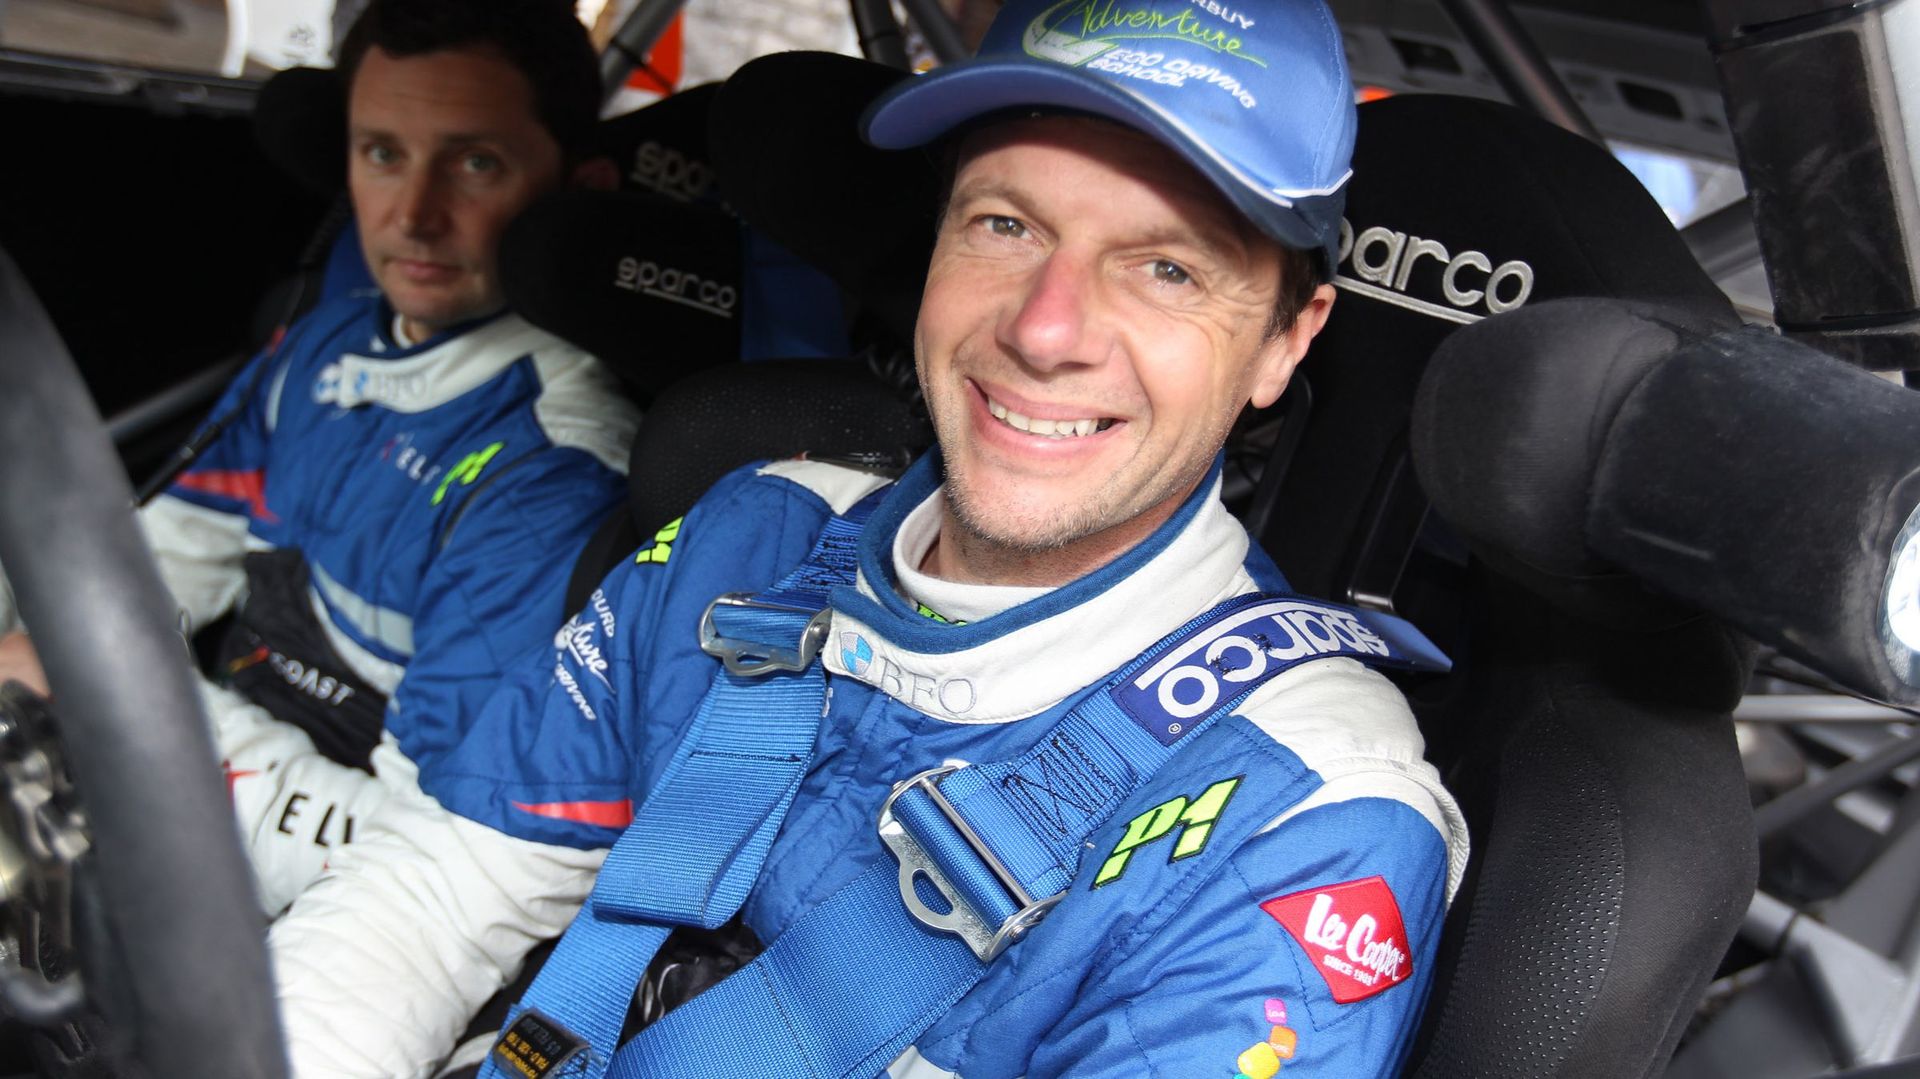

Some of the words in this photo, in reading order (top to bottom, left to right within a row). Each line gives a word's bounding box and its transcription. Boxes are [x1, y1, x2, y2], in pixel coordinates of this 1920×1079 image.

[1086, 58, 1189, 88] SCHOOL
[1104, 49, 1164, 67] ECO
[1163, 58, 1257, 109] DRIVING
[616, 255, 737, 312] sparco
[1157, 604, 1391, 719] sparco
[1090, 774, 1247, 892] P1
